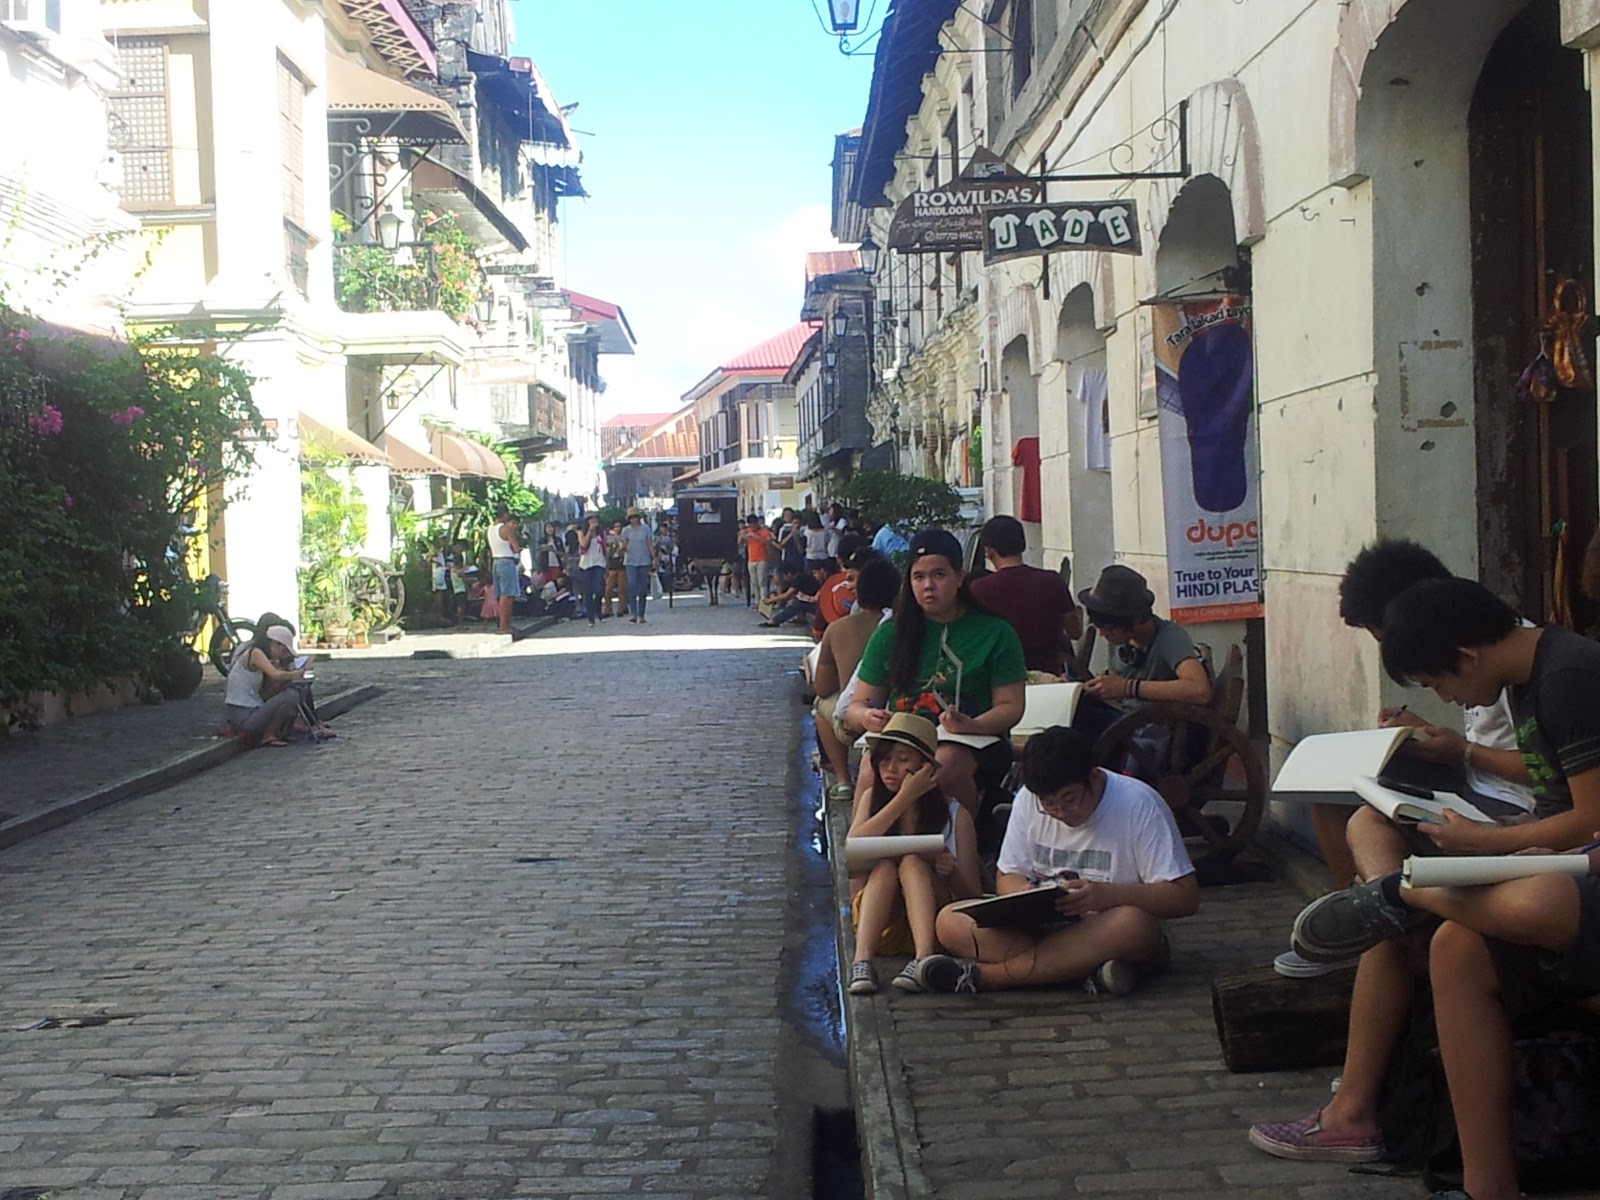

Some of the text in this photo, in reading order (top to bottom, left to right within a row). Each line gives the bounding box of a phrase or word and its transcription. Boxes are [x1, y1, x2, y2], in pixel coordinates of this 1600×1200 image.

[913, 187, 1033, 207] ROWILDA'S
[914, 205, 974, 217] HANDLOOM
[996, 212, 1128, 247] JADE
[1166, 305, 1252, 346] Tara lakad tayo
[1174, 566, 1254, 582] True to Your
[1176, 581, 1220, 598] HINDI
